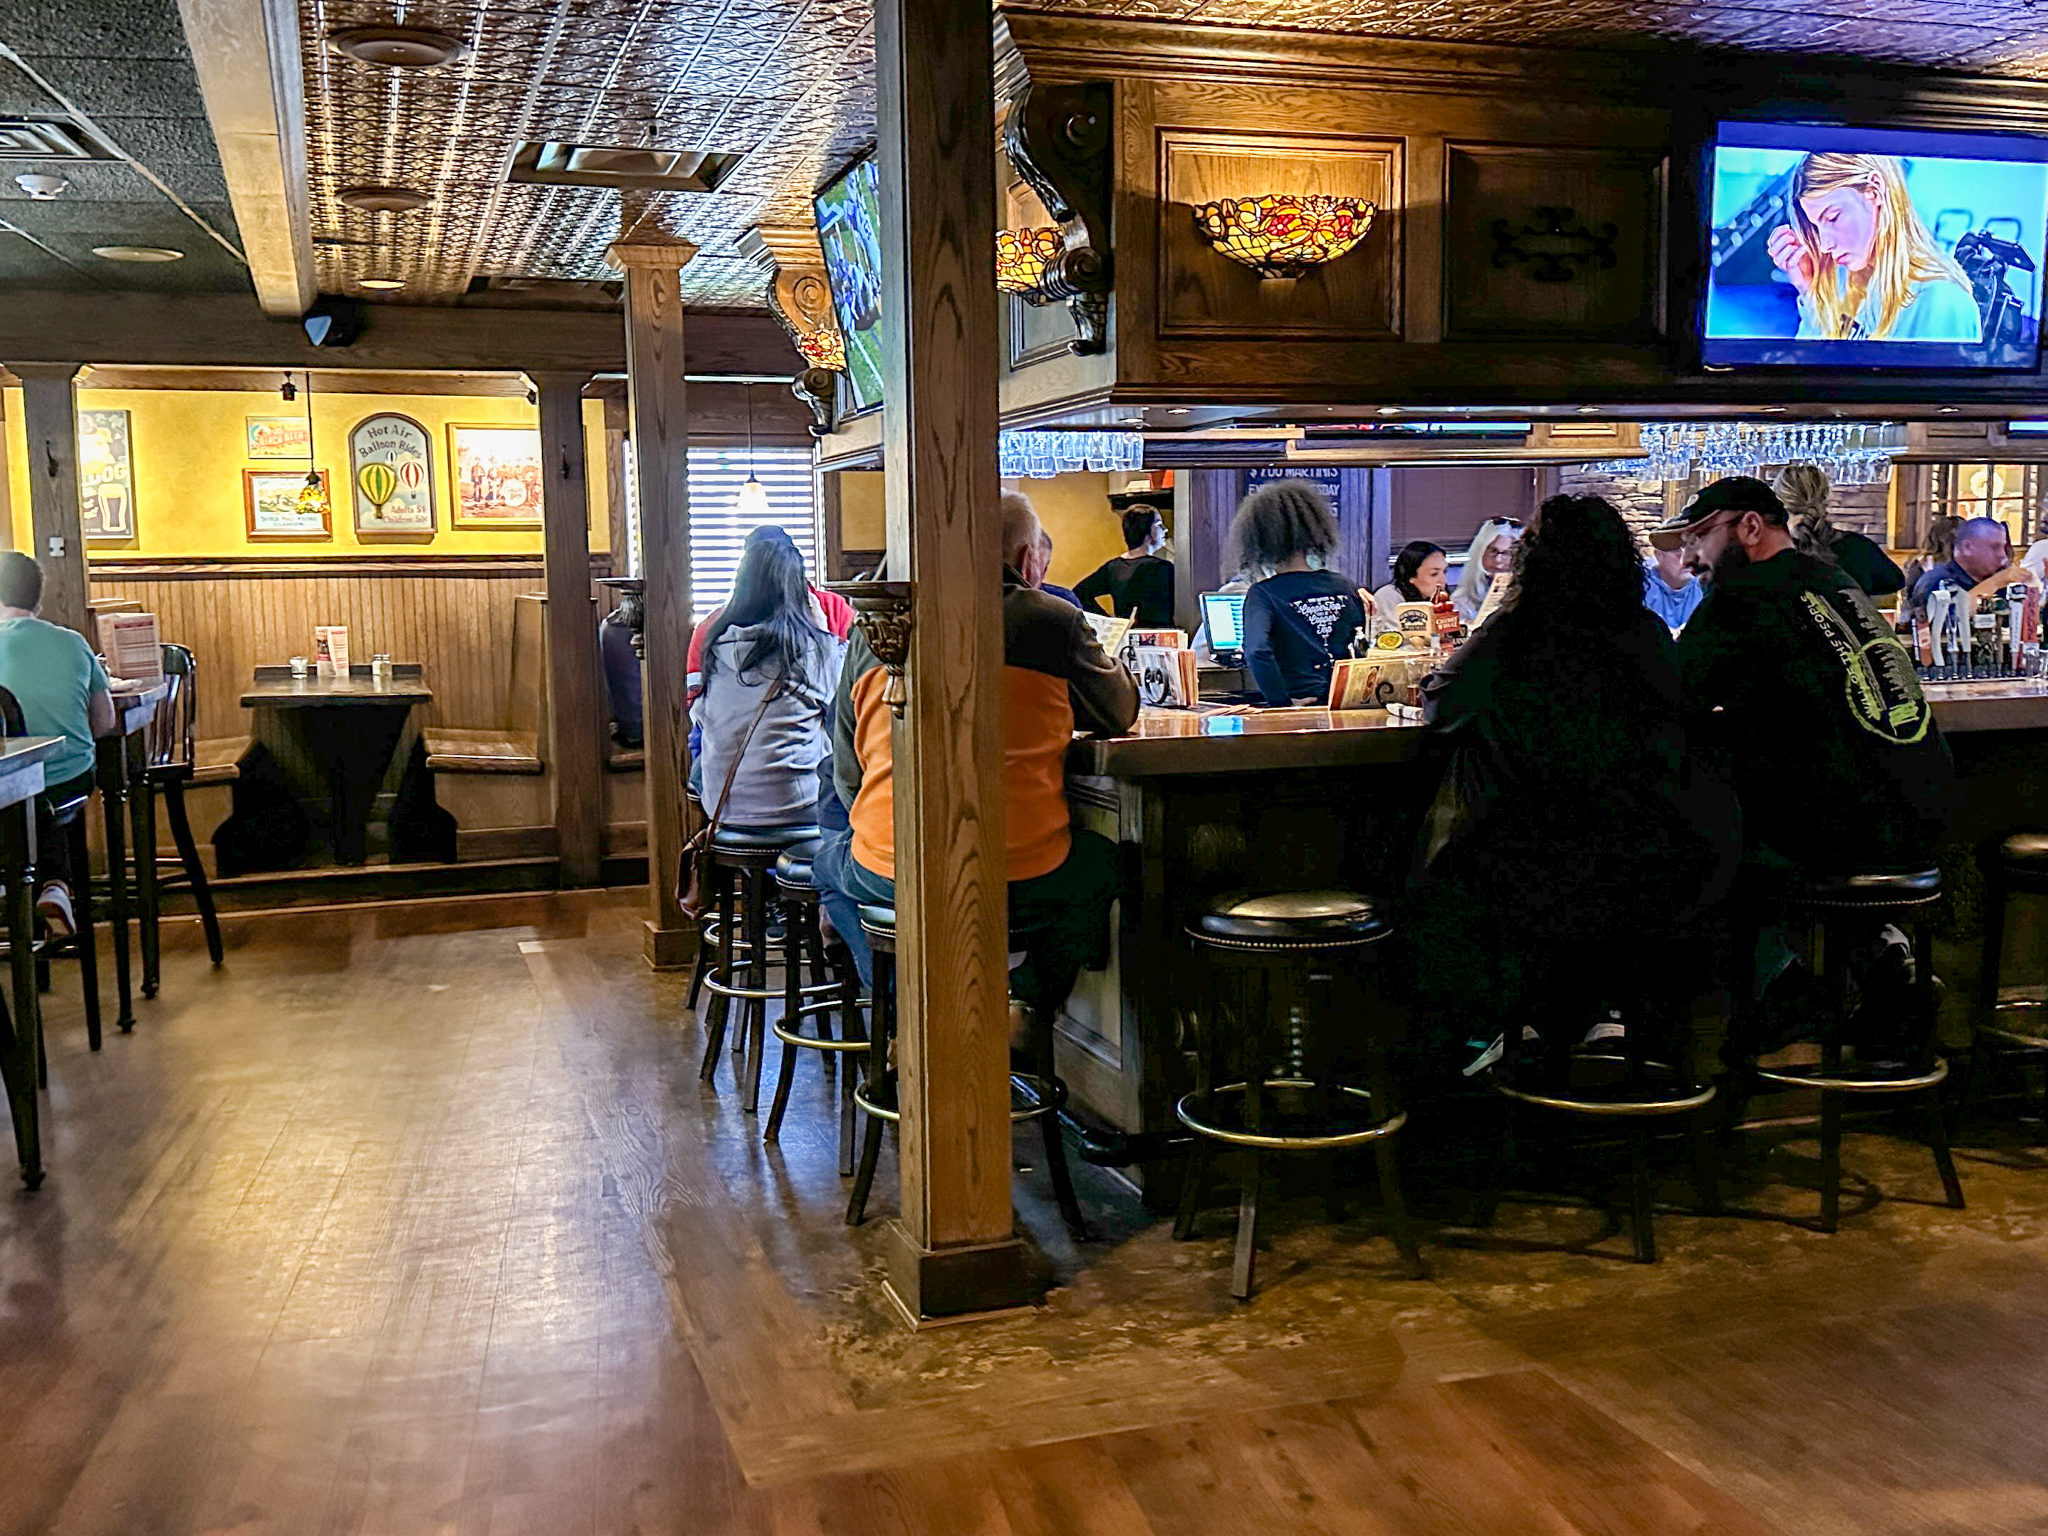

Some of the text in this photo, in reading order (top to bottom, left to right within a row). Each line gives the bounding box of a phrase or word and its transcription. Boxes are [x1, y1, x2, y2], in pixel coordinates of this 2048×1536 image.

[284, 431, 304, 442] BEER
[367, 424, 413, 439] Hot Air
[358, 440, 423, 459] Balloon Rides
[1285, 468, 1339, 478] MARTINIS
[391, 504, 414, 514] Adults
[383, 515, 414, 524] Children
[1309, 614, 1338, 625] Copper
[1316, 624, 1333, 635] Top
[1831, 639, 1849, 665] THE
[1847, 667, 1858, 684] OF
